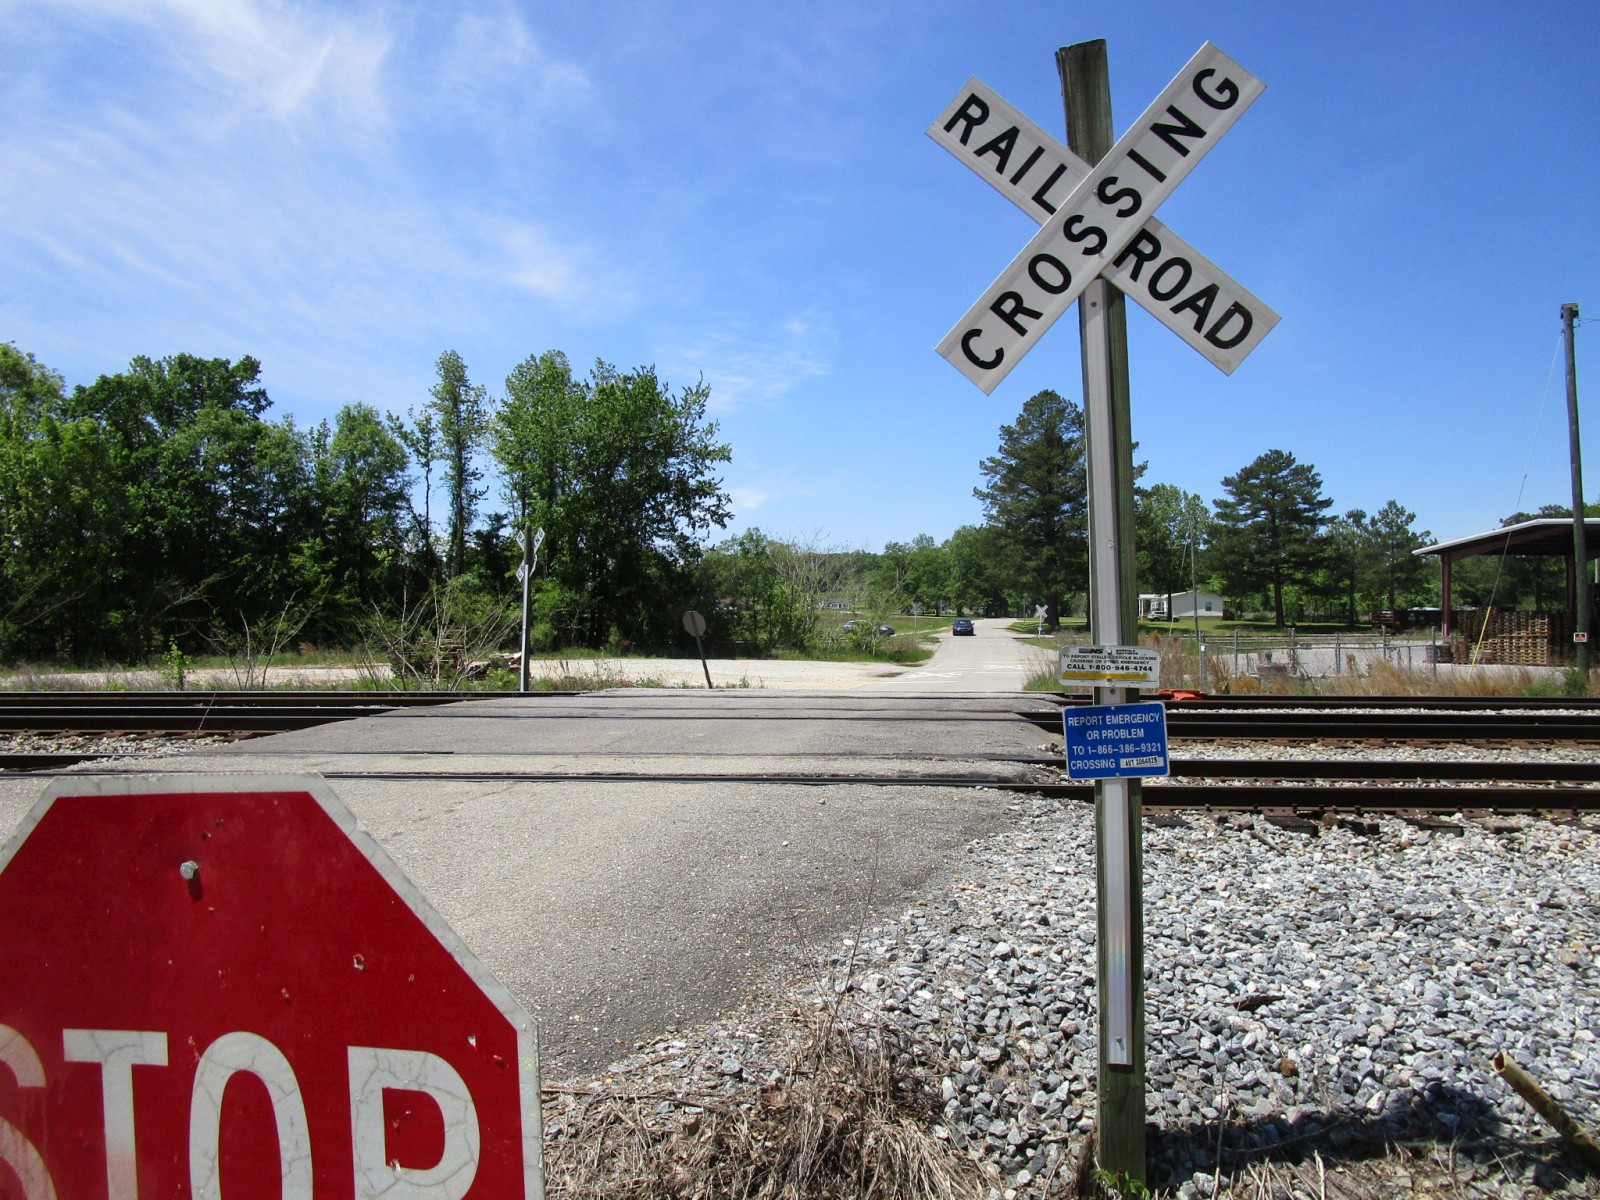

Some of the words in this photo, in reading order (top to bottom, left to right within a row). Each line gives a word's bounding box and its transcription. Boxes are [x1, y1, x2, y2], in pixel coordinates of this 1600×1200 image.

[943, 93, 1068, 215] RAIL
[1112, 228, 1253, 350] ROAD
[961, 68, 1239, 370] CROSSING
[1068, 716, 1103, 726] REPORT
[1106, 713, 1160, 724] EMERGENCY
[1086, 730, 1099, 740] OR
[1102, 728, 1144, 739] PROBLEM
[1072, 746, 1085, 756] TO
[1087, 743, 1161, 754] 1-866-386-9321
[1071, 759, 1116, 770] CROSSING
[0, 1024, 481, 1200] TOP
